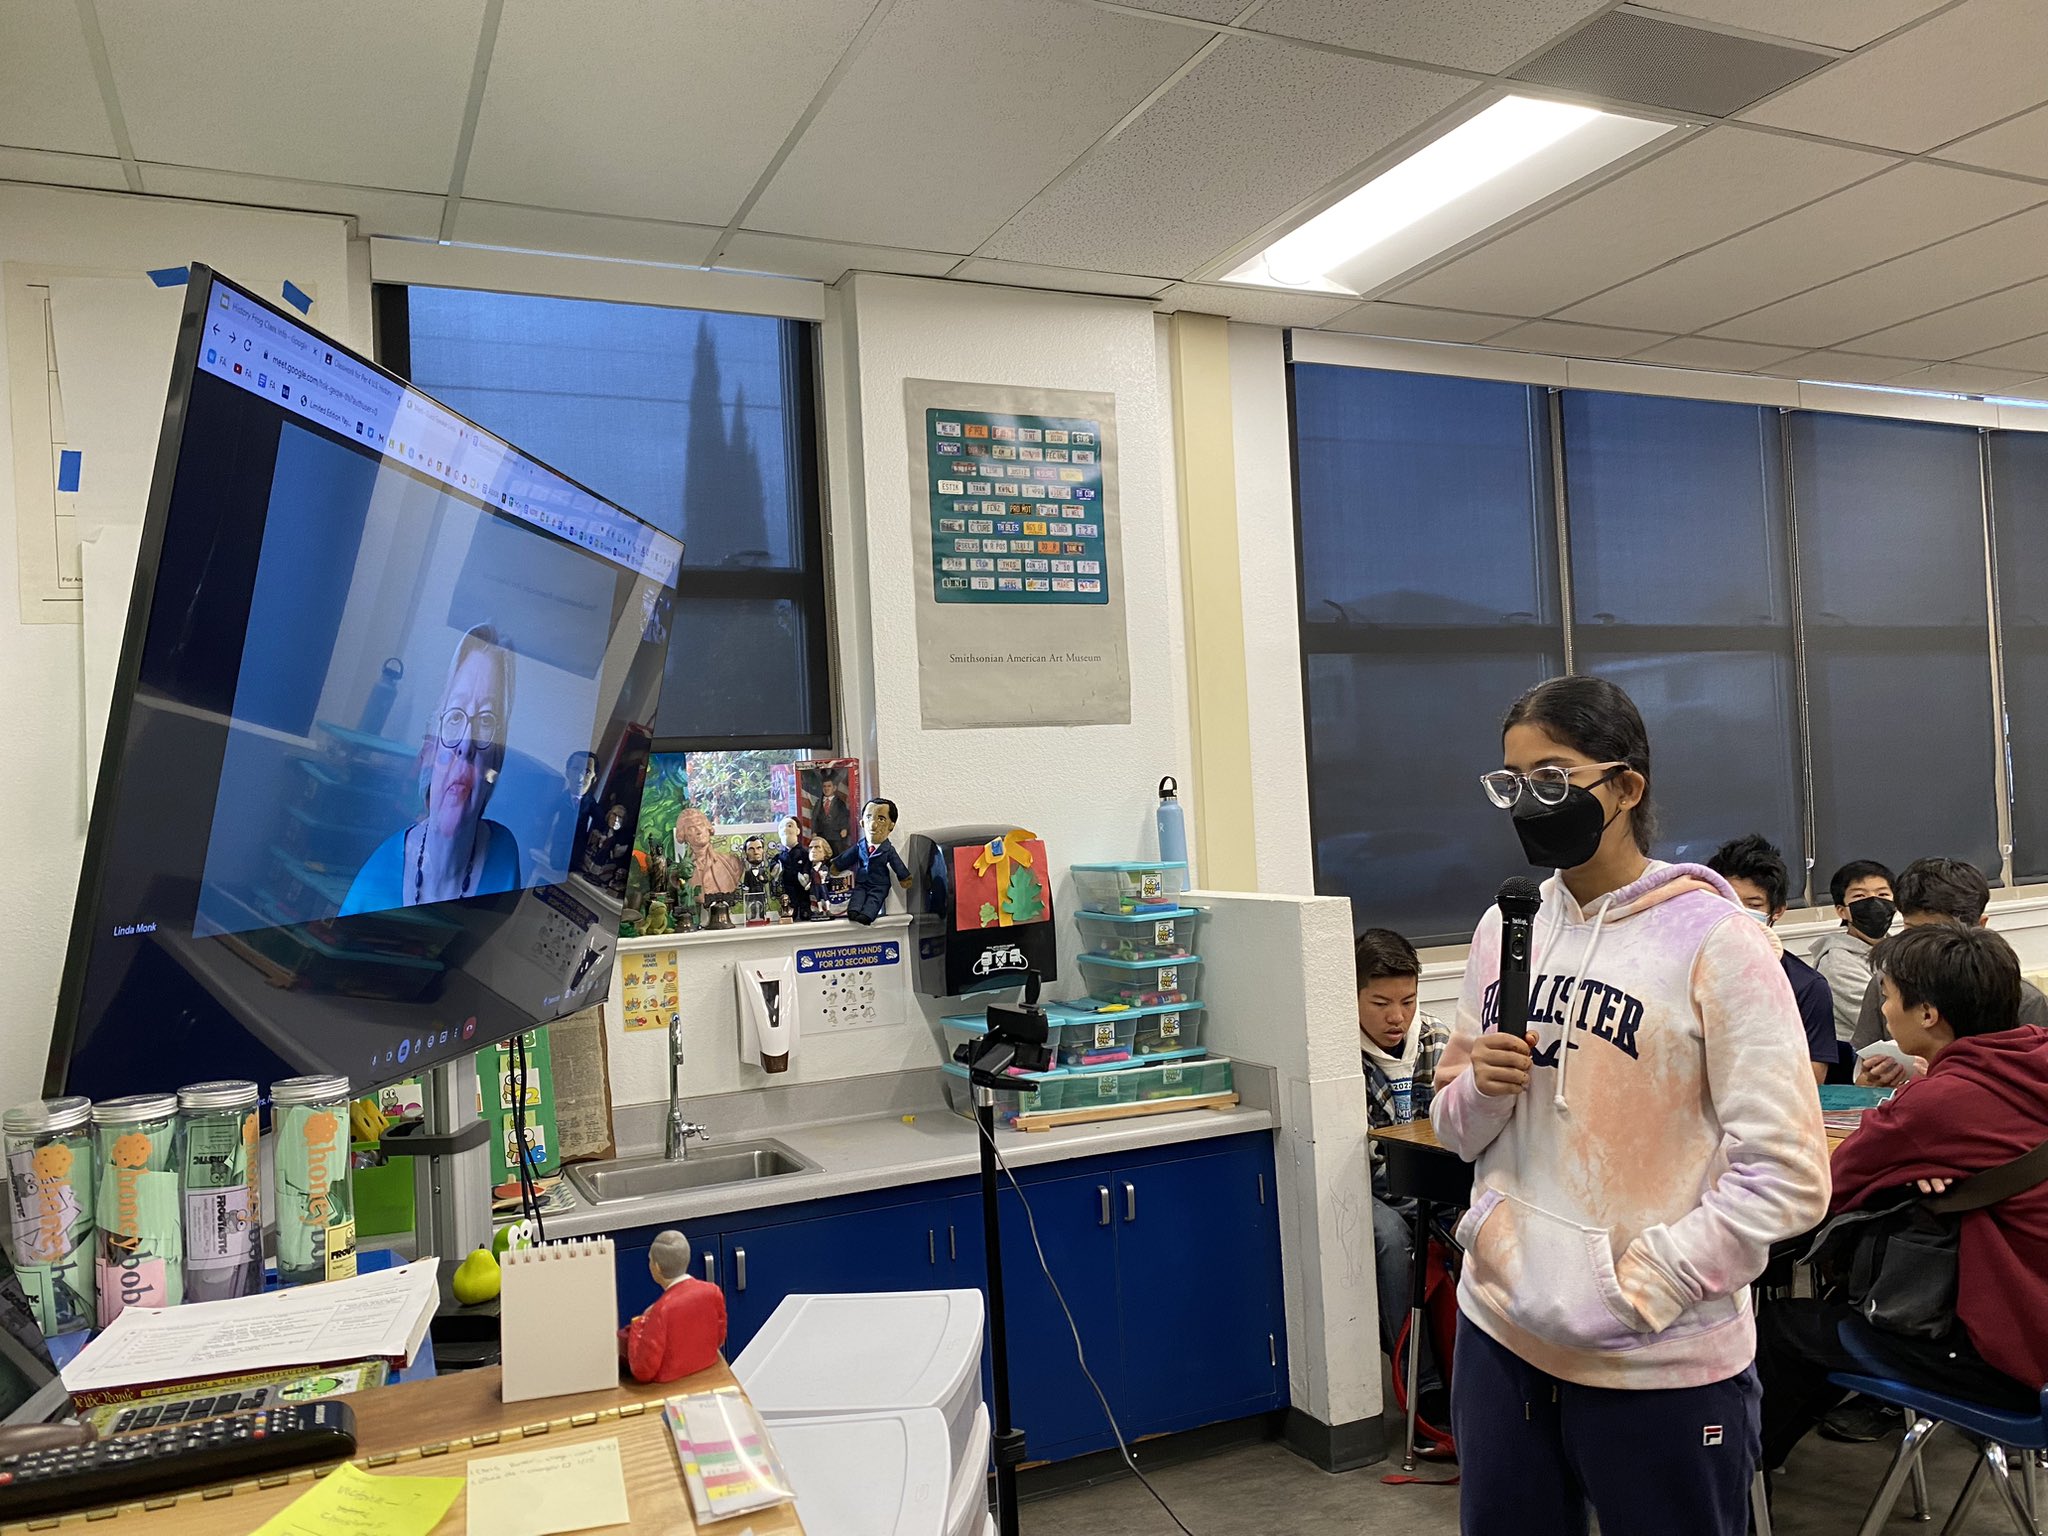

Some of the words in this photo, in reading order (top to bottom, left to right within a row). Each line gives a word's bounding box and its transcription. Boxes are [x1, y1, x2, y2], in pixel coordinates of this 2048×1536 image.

[949, 653, 1003, 662] Smithsonian
[1006, 653, 1046, 662] American
[1049, 653, 1062, 662] Art
[1066, 653, 1101, 662] Museum
[114, 924, 135, 936] Linda
[136, 922, 157, 933] Monk
[815, 950, 836, 959] WASH
[837, 948, 857, 957] YOUR
[858, 945, 882, 954] HANDS
[819, 960, 833, 969] FOR
[834, 959, 843, 967] 20
[845, 956, 879, 966] SECONDS
[1481, 974, 1644, 1060] HLLISTER
[299, 1143, 336, 1229] honey
[109, 1167, 151, 1252] honey
[120, 1249, 154, 1305] bob
[246, 1366, 319, 1381] CONSTITUTION
